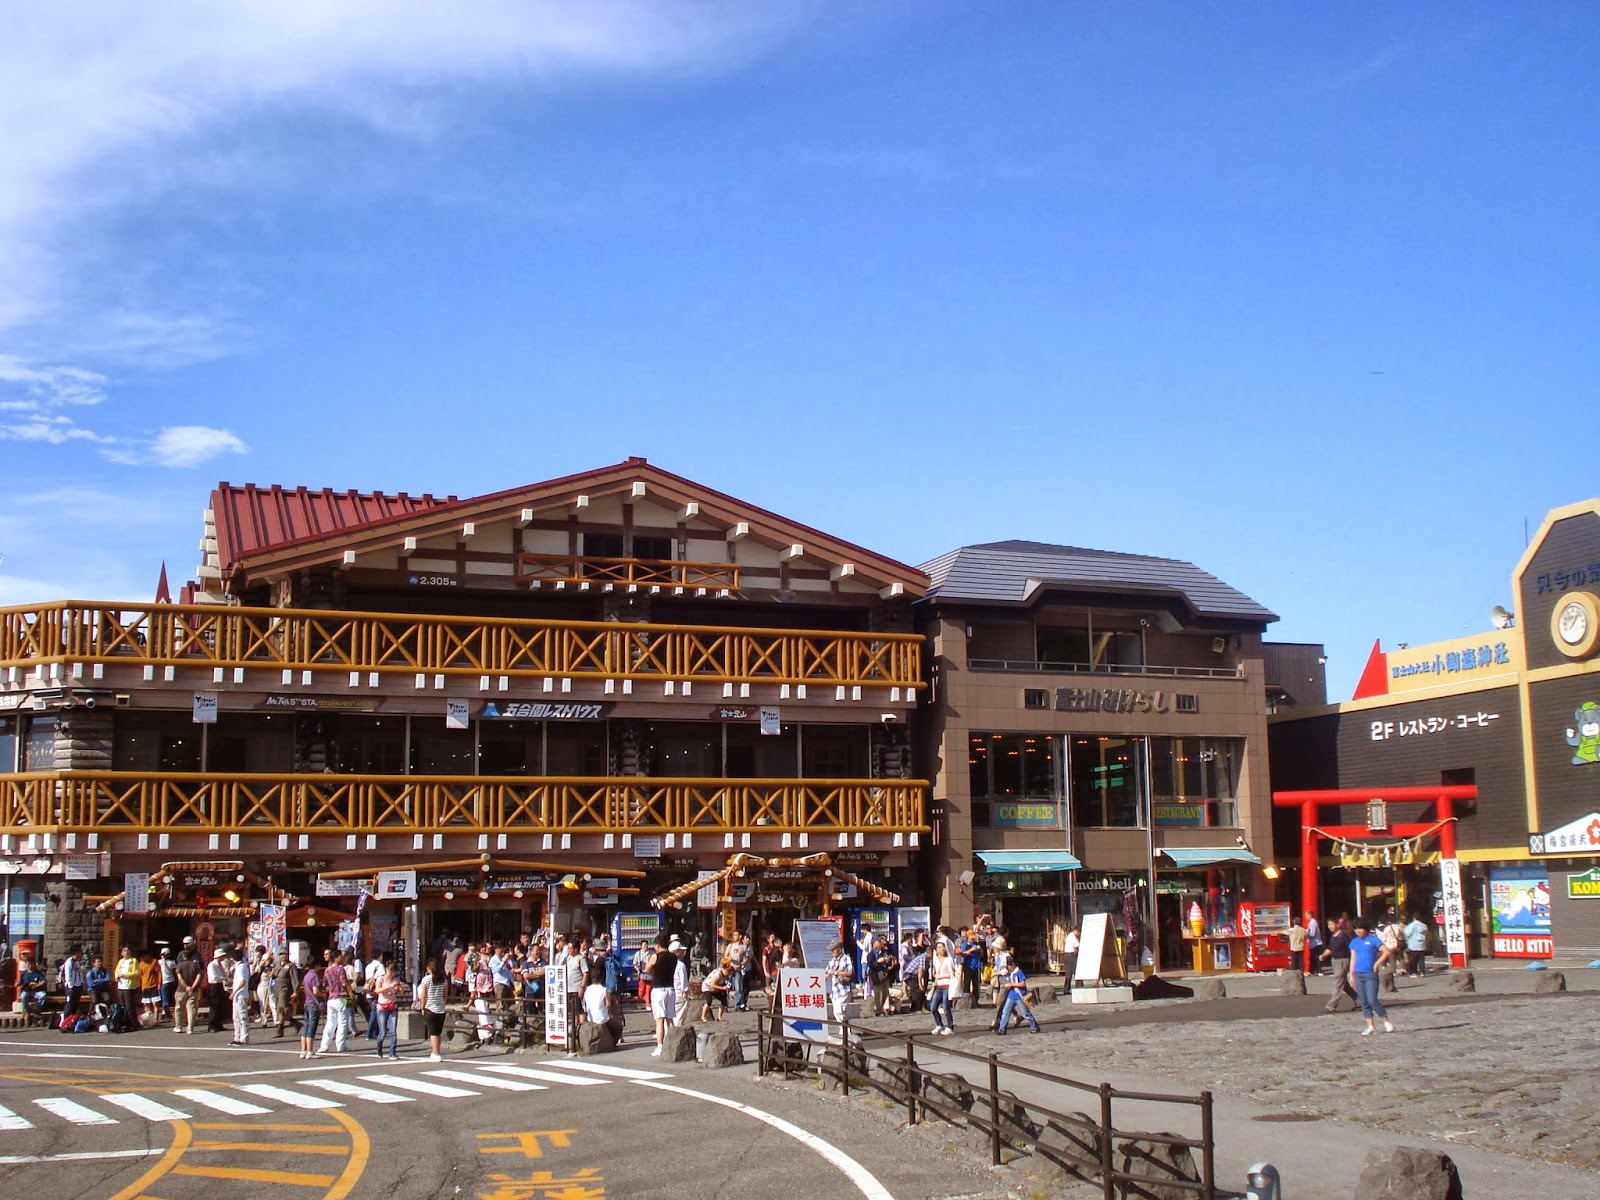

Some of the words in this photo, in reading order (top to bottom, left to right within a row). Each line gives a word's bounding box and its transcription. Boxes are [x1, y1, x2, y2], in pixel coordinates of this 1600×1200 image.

[502, 703, 602, 719] 五合園レストハウス
[1371, 721, 1394, 741] 2F
[1000, 806, 1053, 819] COFFEE
[274, 908, 286, 946] ソフト
[1495, 938, 1524, 953] HELLO
[787, 976, 822, 988] バス
[785, 994, 825, 1008] 駐車場
